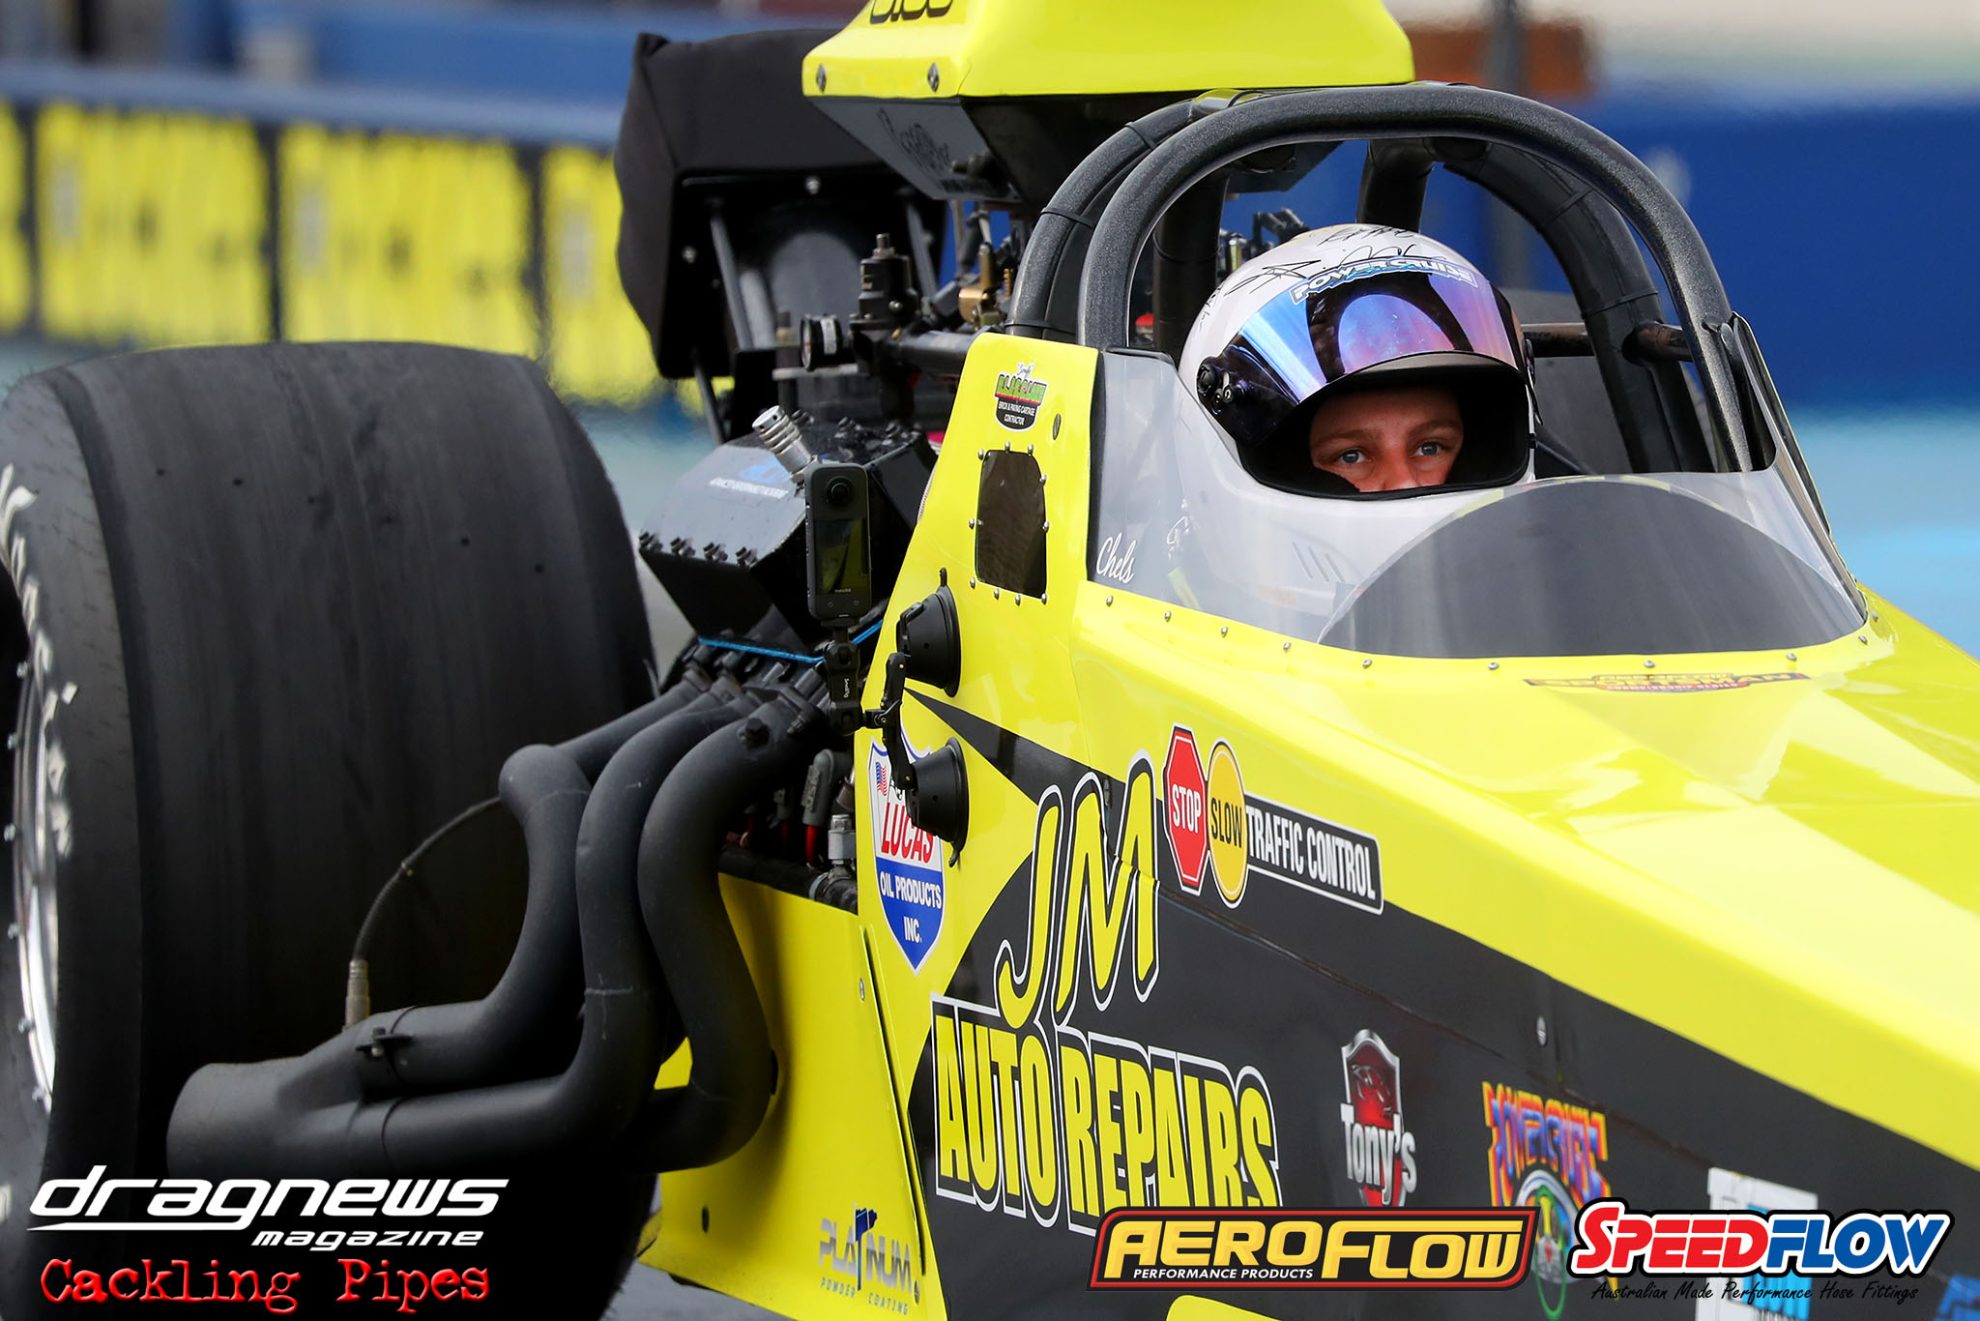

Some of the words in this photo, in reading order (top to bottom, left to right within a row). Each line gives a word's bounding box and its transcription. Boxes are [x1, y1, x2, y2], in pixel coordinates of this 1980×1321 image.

[1096, 532, 1136, 584] Chels
[881, 801, 934, 864] LUCAS
[1172, 784, 1201, 833] STOP
[1211, 798, 1242, 848] SLOW
[1246, 805, 1304, 875] TRAFFIC
[1307, 827, 1376, 900] CONTROL
[880, 871, 894, 899] OIL
[895, 875, 942, 909] PRODUCTS
[996, 756, 1159, 1029] JM
[904, 916, 923, 943] INC.
[935, 1014, 1061, 1208] AUTO
[1060, 1044, 1277, 1217] REPAIRS
[1340, 1102, 1418, 1206] Tony's
